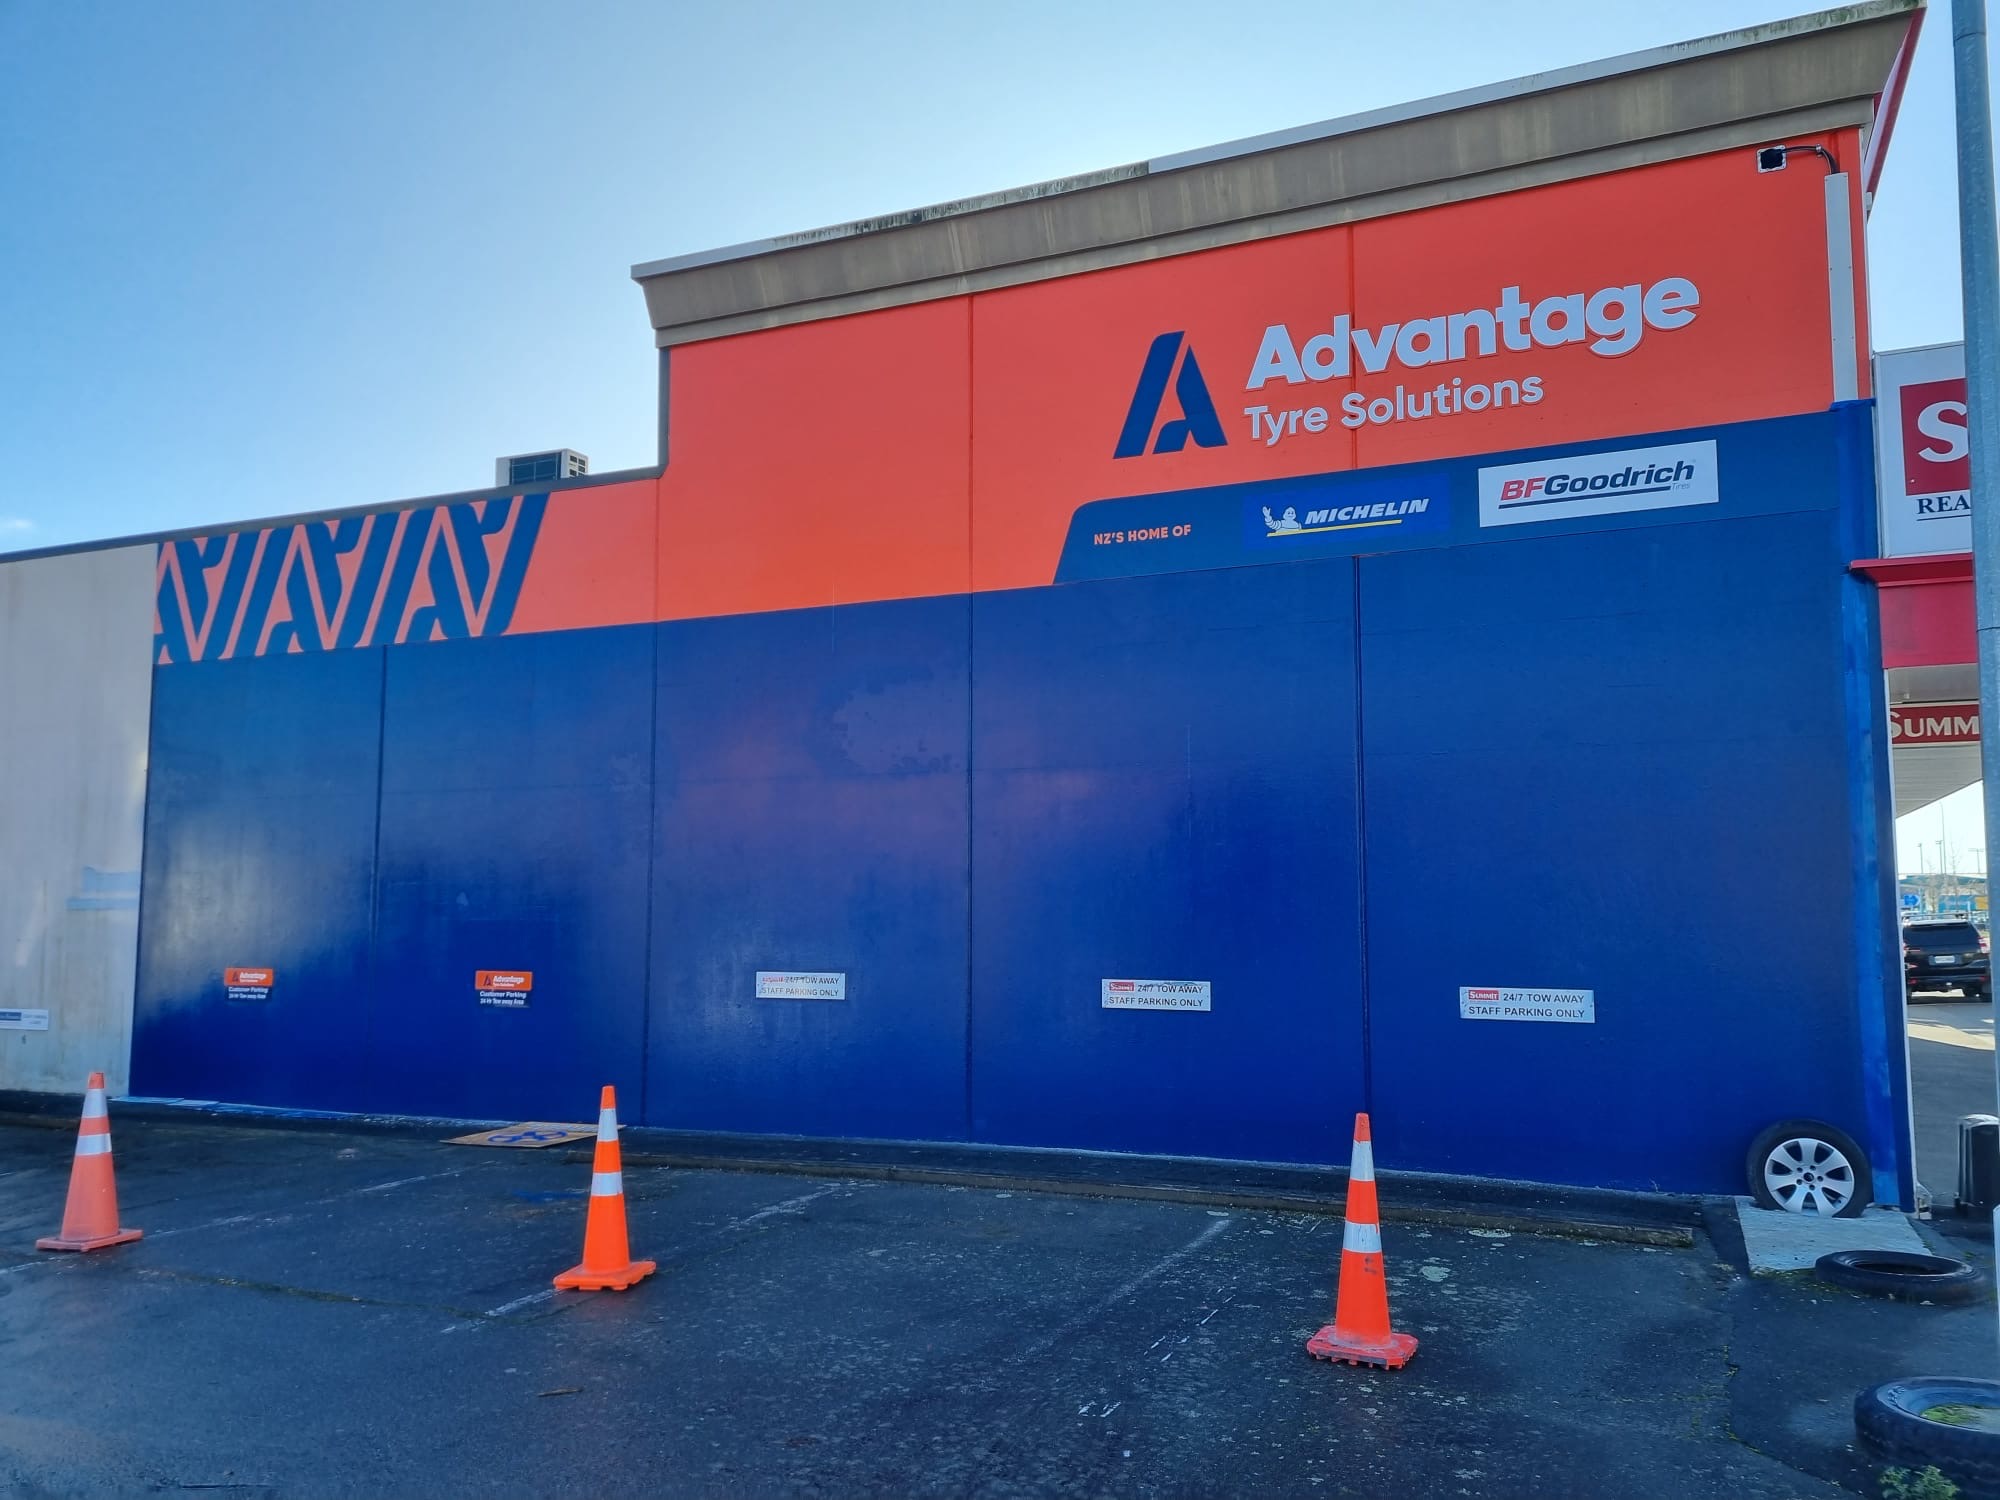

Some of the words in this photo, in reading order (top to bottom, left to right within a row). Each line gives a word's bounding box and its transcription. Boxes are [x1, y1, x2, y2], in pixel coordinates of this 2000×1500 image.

[1245, 276, 1700, 390] Advantage
[1243, 405, 1329, 447] Tyre
[1341, 376, 1545, 428] Solutions
[1500, 460, 1694, 501] BFGoodrich
[1304, 498, 1430, 525] MICHELIN
[1916, 494, 1971, 515] REA
[1093, 531, 1125, 545] NZ'S
[1127, 526, 1169, 542] HOME
[1172, 524, 1192, 537] OF
[1889, 711, 1980, 739] SUMM
[818, 977, 840, 985] AWAY
[1137, 984, 1154, 993] 24/7
[1157, 984, 1179, 994] TOW
[1179, 985, 1204, 994] AWAY
[762, 987, 785, 995] STAFF
[785, 988, 818, 997] PARKING
[819, 989, 839, 997] ONLY
[1109, 996, 1136, 1005] STAFF
[1137, 997, 1178, 1007] PARKING
[1179, 998, 1204, 1008] ONLY
[1503, 993, 1524, 1002] 24/7
[1526, 993, 1552, 1003] TOW
[1553, 994, 1585, 1004] AWAY
[1468, 1006, 1501, 1016] STAFF
[1504, 1006, 1553, 1018] PARKING
[1555, 1008, 1585, 1019] ONLY
